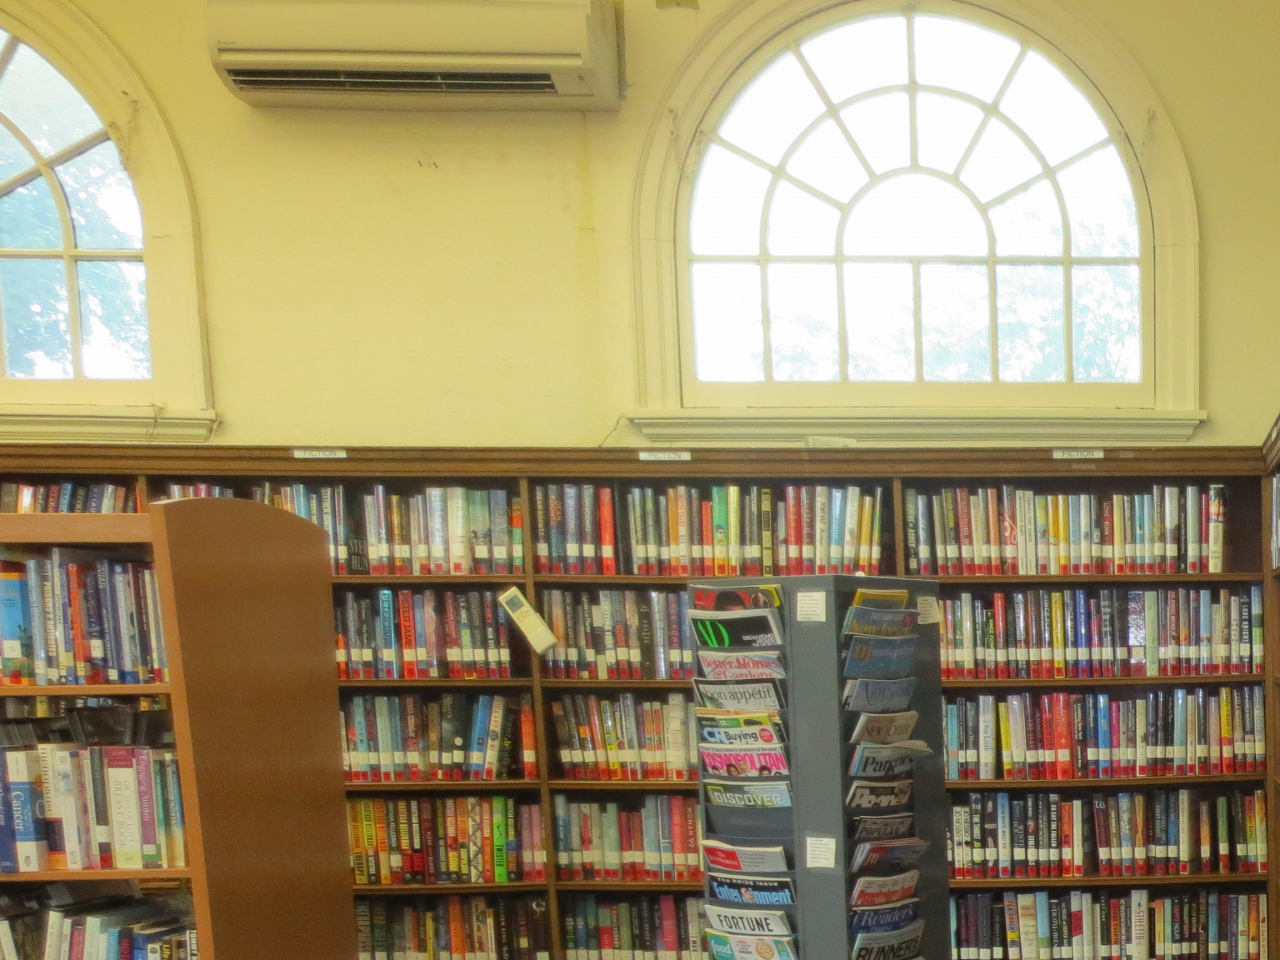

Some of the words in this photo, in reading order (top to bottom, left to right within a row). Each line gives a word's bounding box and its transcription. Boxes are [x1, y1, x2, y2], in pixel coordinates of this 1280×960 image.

[304, 449, 336, 457] FICTION
[649, 451, 681, 459] FICTION
[1062, 449, 1094, 458] FICTION
[733, 683, 777, 702] appétit
[724, 729, 759, 744] Buying
[138, 755, 150, 791] Engaging
[40, 747, 56, 817] menopause
[113, 780, 125, 817] BREAST
[713, 790, 782, 806] DISCOVER
[9, 790, 27, 832] Cancer
[140, 794, 152, 822] Autism
[954, 808, 962, 816] JO
[964, 808, 971, 816] JO
[972, 814, 982, 823] THE
[1050, 812, 1058, 822] SAY
[118, 820, 129, 850] BOOK
[859, 826, 899, 839] POPULAR
[963, 817, 971, 837] NESBO
[972, 825, 982, 839] THIRST
[1050, 831, 1058, 847] FALLEN
[356, 851, 365, 877] THERAPY
[449, 851, 458, 871] GONE
[495, 843, 504, 868] TWISTED
[732, 878, 754, 886] PRIDE
[716, 914, 774, 933] FORTUNE
[861, 903, 914, 927] Reader's
[1135, 909, 1145, 940] STILETTO
[190, 929, 199, 955] TOMMY
[711, 941, 733, 956] food
[162, 944, 171, 959] Life
